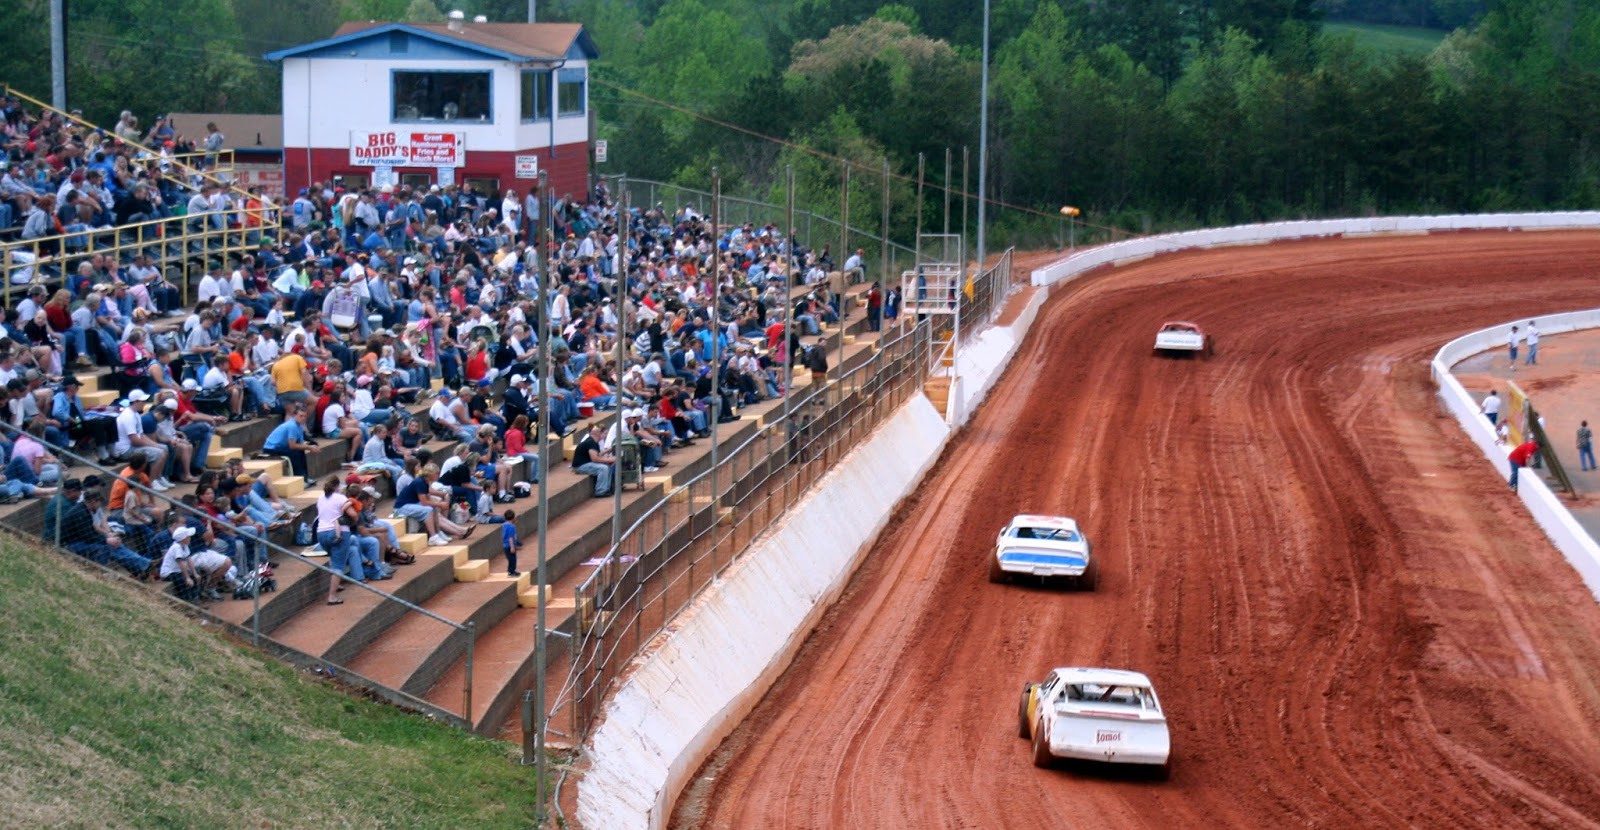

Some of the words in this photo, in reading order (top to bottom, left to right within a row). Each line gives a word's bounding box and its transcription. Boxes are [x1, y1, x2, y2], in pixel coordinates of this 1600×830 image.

[368, 132, 396, 147] BIG
[423, 134, 442, 142] Great
[355, 146, 409, 158] DADDY'S
[417, 148, 434, 156] Fries
[435, 148, 449, 156] and
[433, 155, 453, 163] More!
